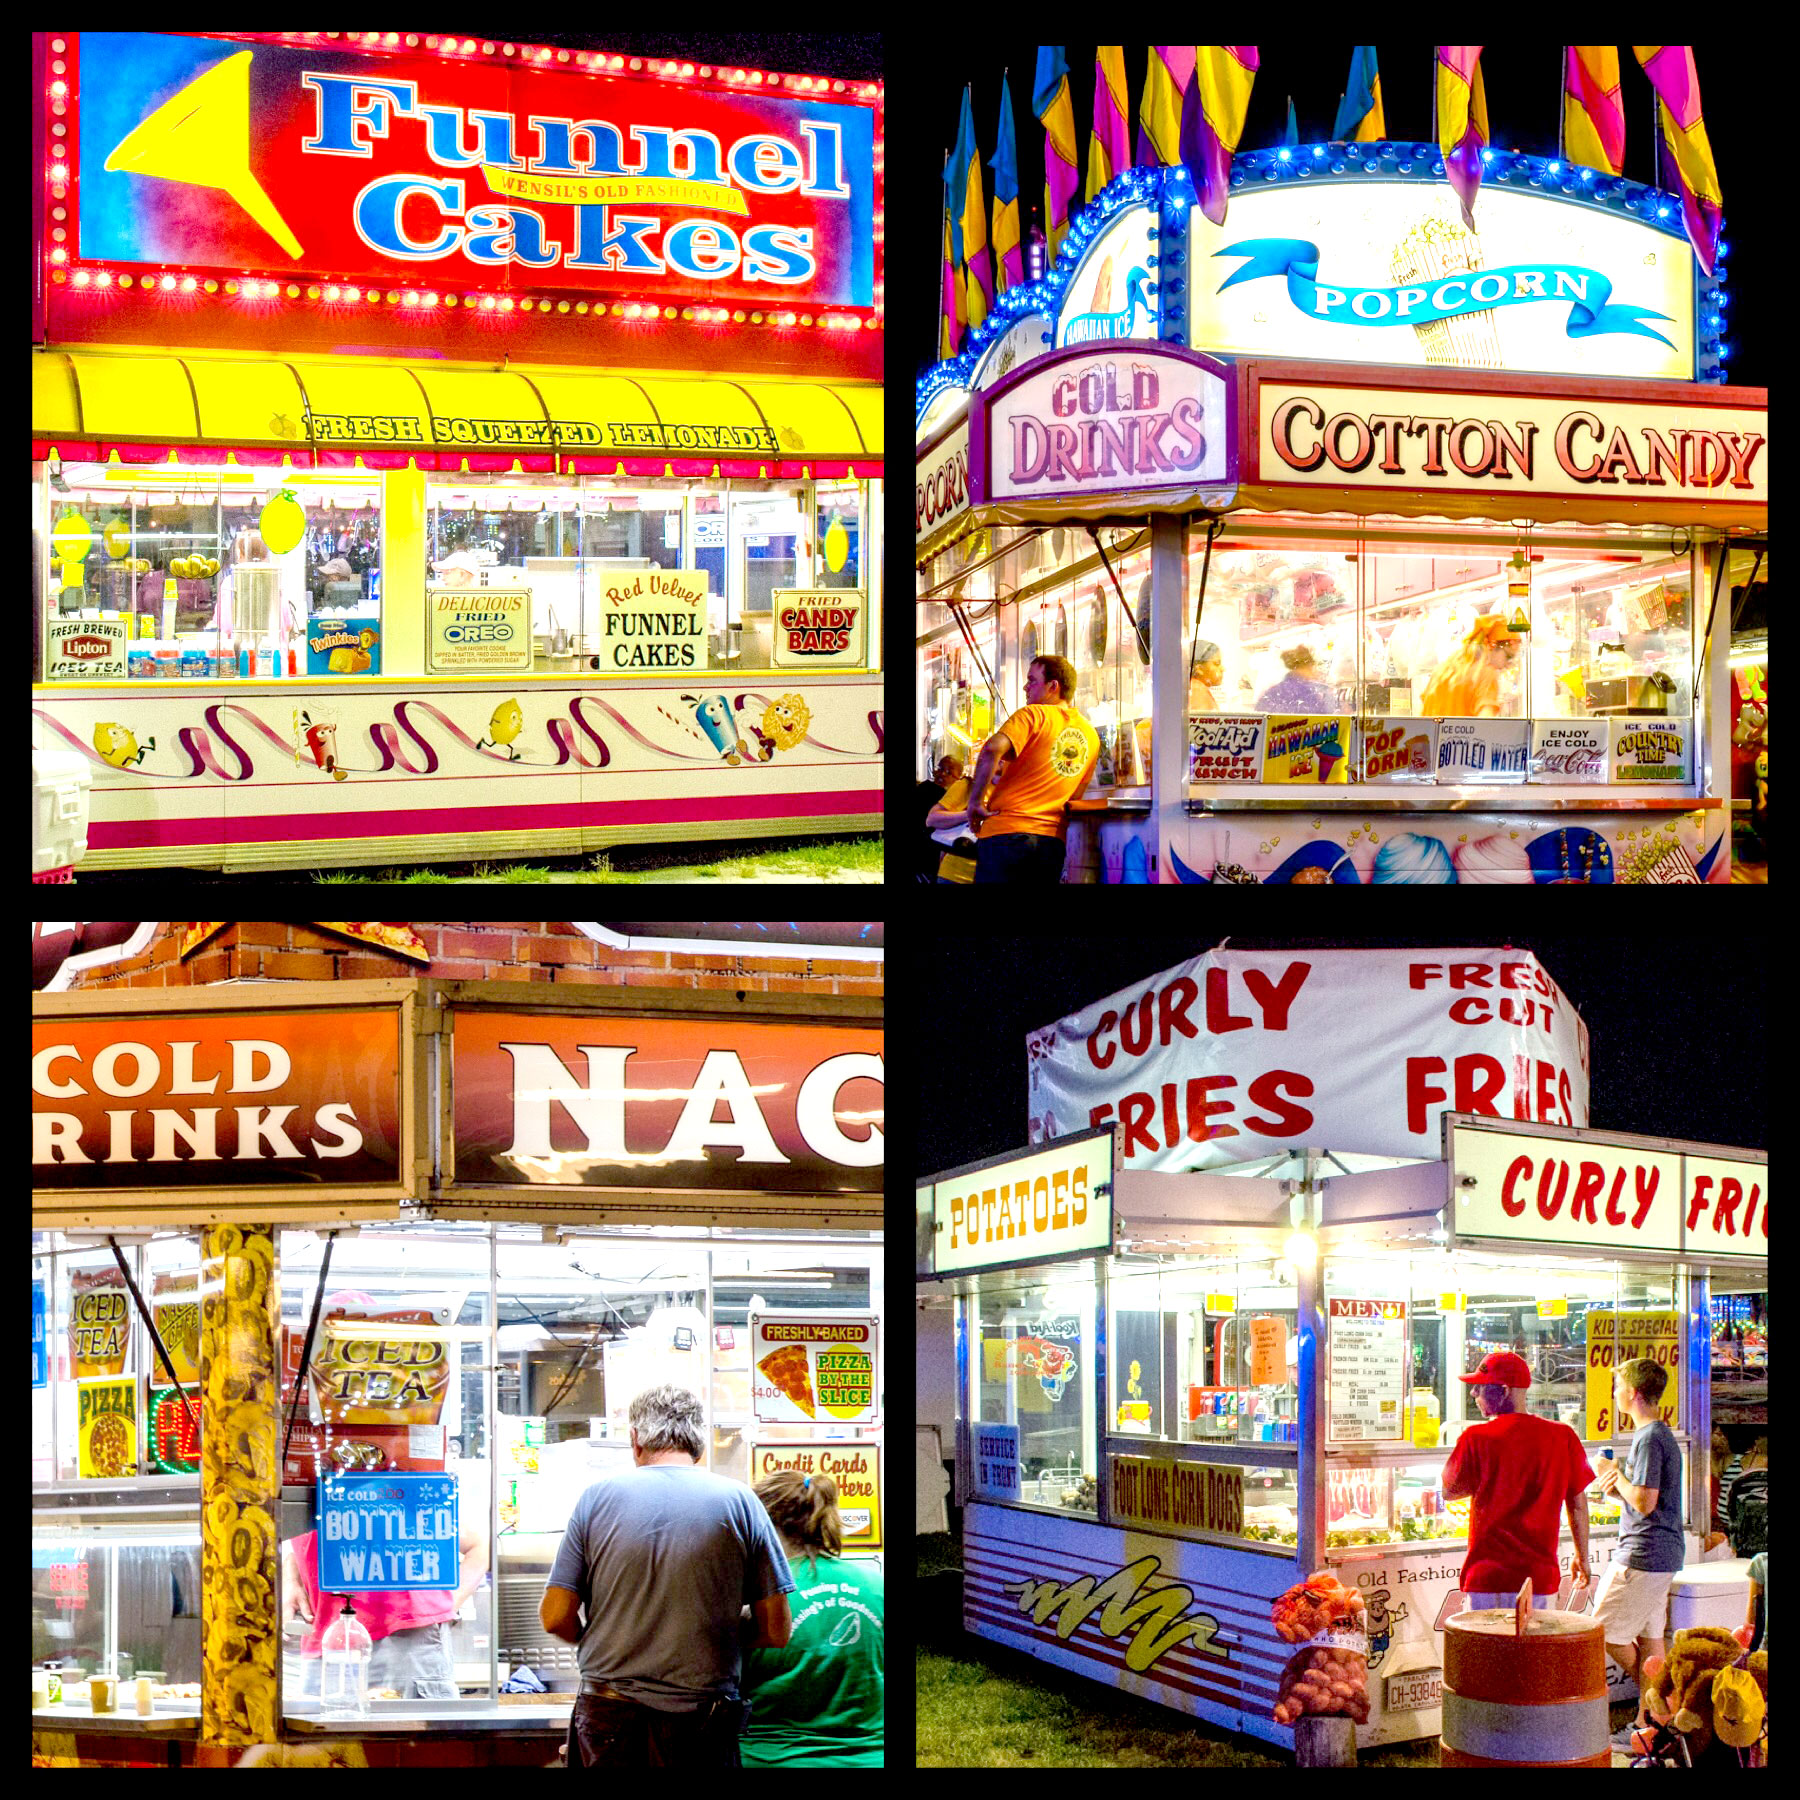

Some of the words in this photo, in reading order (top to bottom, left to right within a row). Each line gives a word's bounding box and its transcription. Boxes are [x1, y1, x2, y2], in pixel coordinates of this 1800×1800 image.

[302, 70, 850, 199] Funnel
[501, 175, 588, 198] WENSIL'S
[594, 184, 628, 198] OLD
[353, 174, 816, 285] Cakes
[1315, 271, 1589, 319] POPCORN
[1067, 317, 1110, 346] HAWAIIAN
[1115, 308, 1132, 340] ICE
[1052, 362, 1159, 418] COLD
[302, 414, 423, 441] FRESH
[433, 417, 602, 445] SQUEEZED
[608, 423, 780, 450] LEMONADE
[1009, 397, 1207, 484] DRINKS
[1272, 397, 1539, 480] COTTON
[1556, 411, 1765, 489] CANDY
[606, 577, 644, 607] Red
[650, 576, 703, 607] Velvet
[799, 597, 842, 606] FRIED
[438, 597, 522, 611] DELICIOUS
[456, 613, 506, 621] FRIED
[605, 613, 703, 636] FUNNEL
[780, 607, 859, 629] CANDY
[51, 624, 81, 638] FRESH
[83, 624, 122, 638] BREWED
[310, 632, 359, 653] Twinkies
[444, 624, 513, 643] OREO
[787, 630, 850, 651] BARS
[67, 641, 108, 656] Lipton
[613, 643, 695, 667] CAKES
[51, 662, 88, 673] ICED
[94, 662, 122, 673] TEA
[1190, 725, 1261, 755] Kool-Aid
[1268, 719, 1340, 759] HAWAIIAN
[1365, 725, 1406, 755] POP
[1441, 725, 1454, 734] ICE
[1455, 725, 1475, 735] COLD
[1550, 730, 1590, 738] ENJOY
[1439, 736, 1486, 769] BOTTLED
[1491, 743, 1528, 773] WATER
[1542, 739, 1561, 748] ICE
[1565, 739, 1597, 748] COLD
[1617, 731, 1685, 757] COUNTRY
[1193, 755, 1254, 767] RUIT
[1533, 748, 1607, 775] Coca-Cola
[1636, 748, 1667, 764] TIME
[1194, 769, 1257, 779] UNCH
[1616, 765, 1685, 780] LEMONADE
[1409, 962, 1560, 1009] FRESH
[1087, 961, 1312, 1070] CURLY
[1449, 997, 1555, 1034] CUT
[32, 1040, 291, 1099] COLD
[500, 1042, 884, 1168] NAC
[1407, 1053, 1573, 1135] FRIES
[32, 1103, 364, 1164] RINKS
[1501, 1154, 1660, 1230] CURLY
[950, 1164, 1089, 1250] POTATOES
[72, 1293, 127, 1322] ICED
[1336, 1300, 1402, 1319] MENU
[1629, 1319, 1678, 1335] SPECIAL
[76, 1326, 121, 1356] TEA
[319, 1335, 442, 1365] ICED
[818, 1355, 870, 1369] PIZZA
[1646, 1344, 1680, 1368] DOG
[332, 1370, 432, 1400] TEA
[820, 1374, 838, 1385] BY
[841, 1374, 869, 1385] THE
[80, 1386, 136, 1425] PIZZA
[820, 1389, 870, 1404] SLICE
[1597, 1408, 1609, 1432] &
[980, 1436, 1015, 1459] SERVICE
[763, 1452, 814, 1474] Credit
[820, 1452, 867, 1474] Cards
[980, 1463, 988, 1484] IN
[326, 1489, 344, 1501] ICE
[347, 1491, 377, 1501] COLD
[836, 1475, 874, 1497] Here
[1113, 1459, 1138, 1516] FOOT
[1141, 1461, 1168, 1521] LONG
[1173, 1464, 1204, 1528] CORN
[1208, 1468, 1241, 1534] DOGS
[326, 1504, 453, 1541] BOTTLED
[340, 1545, 440, 1582] WATER
[1357, 1571, 1388, 1588] Old
